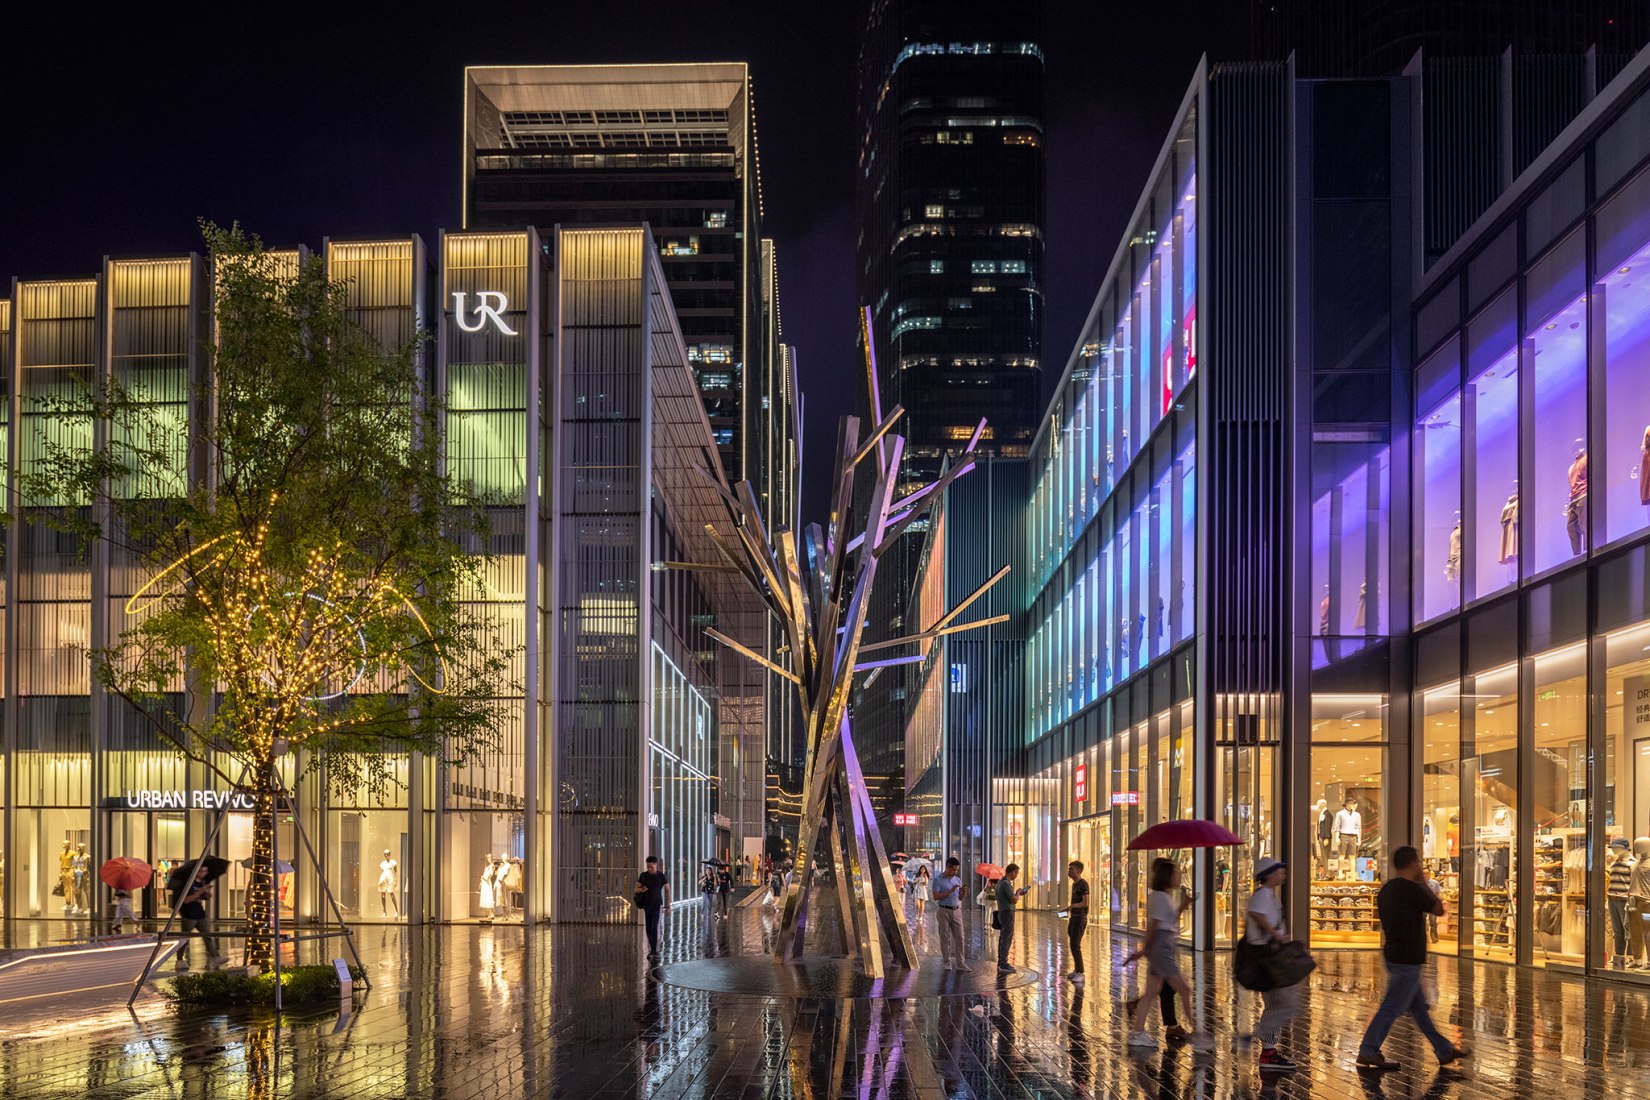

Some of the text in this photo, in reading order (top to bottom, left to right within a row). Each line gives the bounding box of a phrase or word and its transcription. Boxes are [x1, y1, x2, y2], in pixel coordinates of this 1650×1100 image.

[452, 291, 519, 336] UR
[1637, 687, 1650, 700] DR
[127, 790, 186, 808] URBAN
